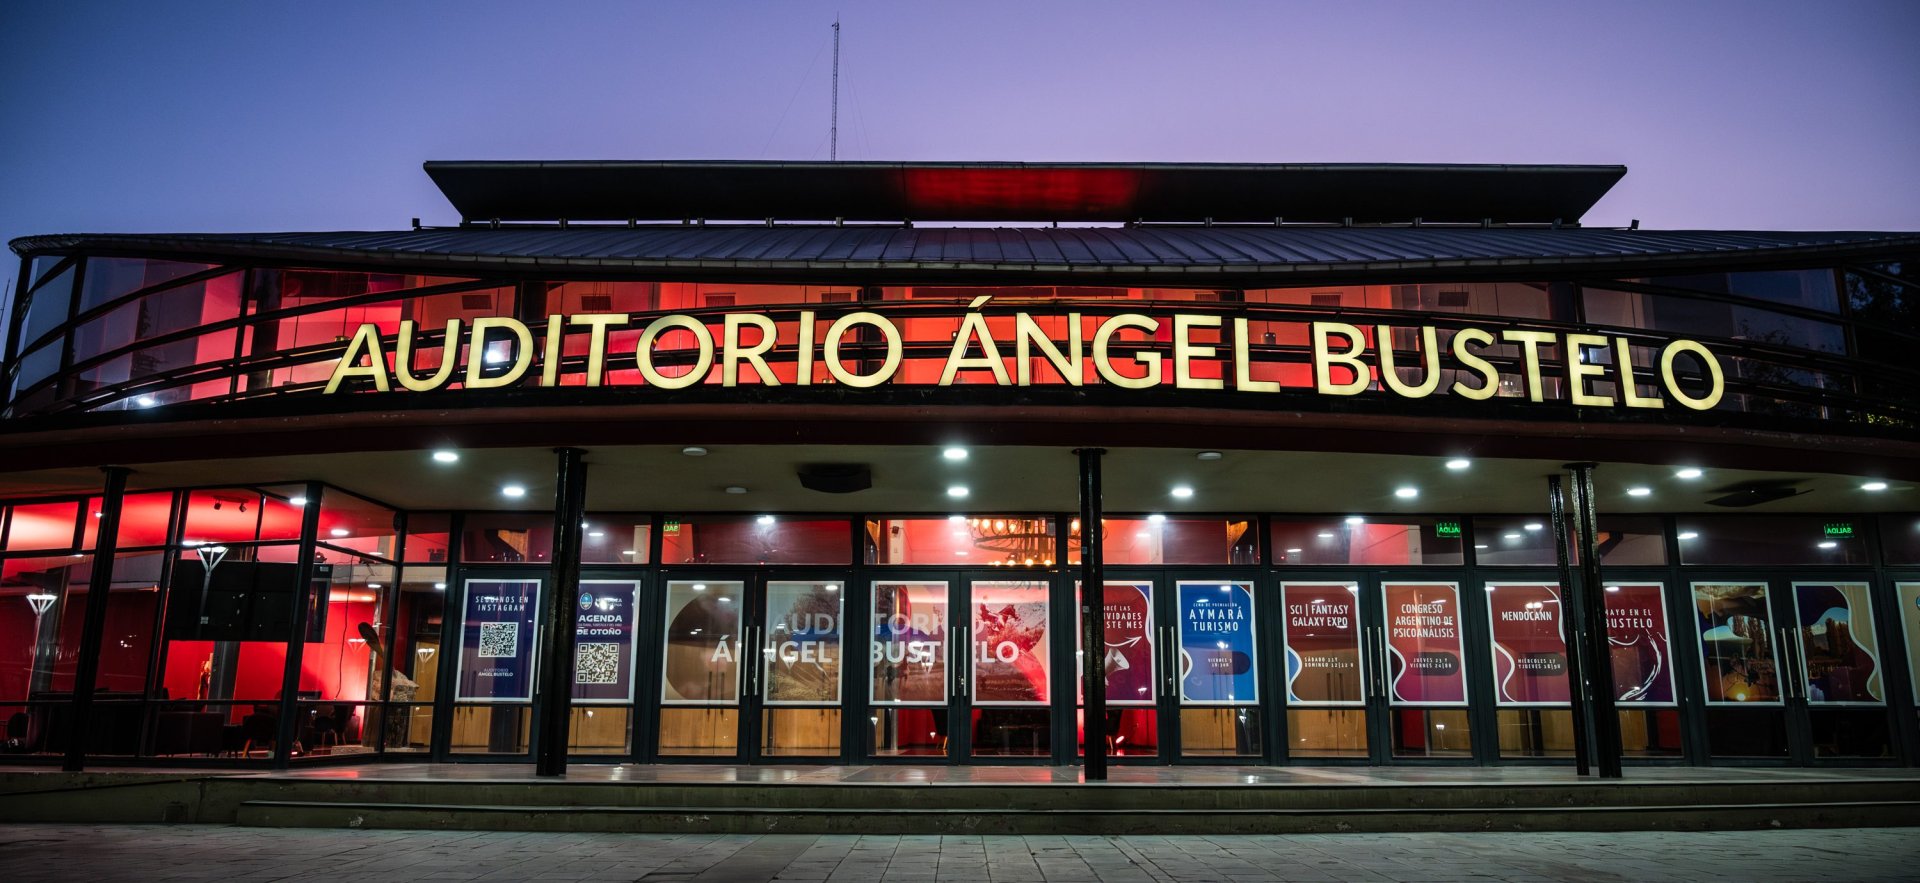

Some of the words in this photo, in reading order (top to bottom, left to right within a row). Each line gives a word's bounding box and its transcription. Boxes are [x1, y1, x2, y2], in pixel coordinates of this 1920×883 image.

[322, 311, 904, 394] AUDITORIO
[938, 295, 1281, 393] ÁNGEL
[1311, 321, 1725, 411] BUSTELO
[475, 595, 515, 603] SEGUINOS
[1189, 606, 1244, 620] AYMARÁ
[1290, 604, 1302, 615] SCI
[1311, 604, 1349, 615] FANTASY
[1401, 603, 1443, 614] CONGRESO
[1629, 608, 1639, 616] EN
[1643, 608, 1652, 616] EL
[578, 614, 623, 622] AGENDA
[1395, 615, 1441, 626] ARGENTINO
[1443, 615, 1453, 626] DE
[1501, 611, 1552, 621] MENDOCANN
[1126, 621, 1143, 629] MES
[1192, 621, 1239, 632] TURISMO
[1292, 616, 1324, 627] GALAXY
[1327, 616, 1348, 628] EXPO
[590, 627, 622, 636] OTOÑO
[1393, 625, 1454, 638] PSICOANÁLISIS
